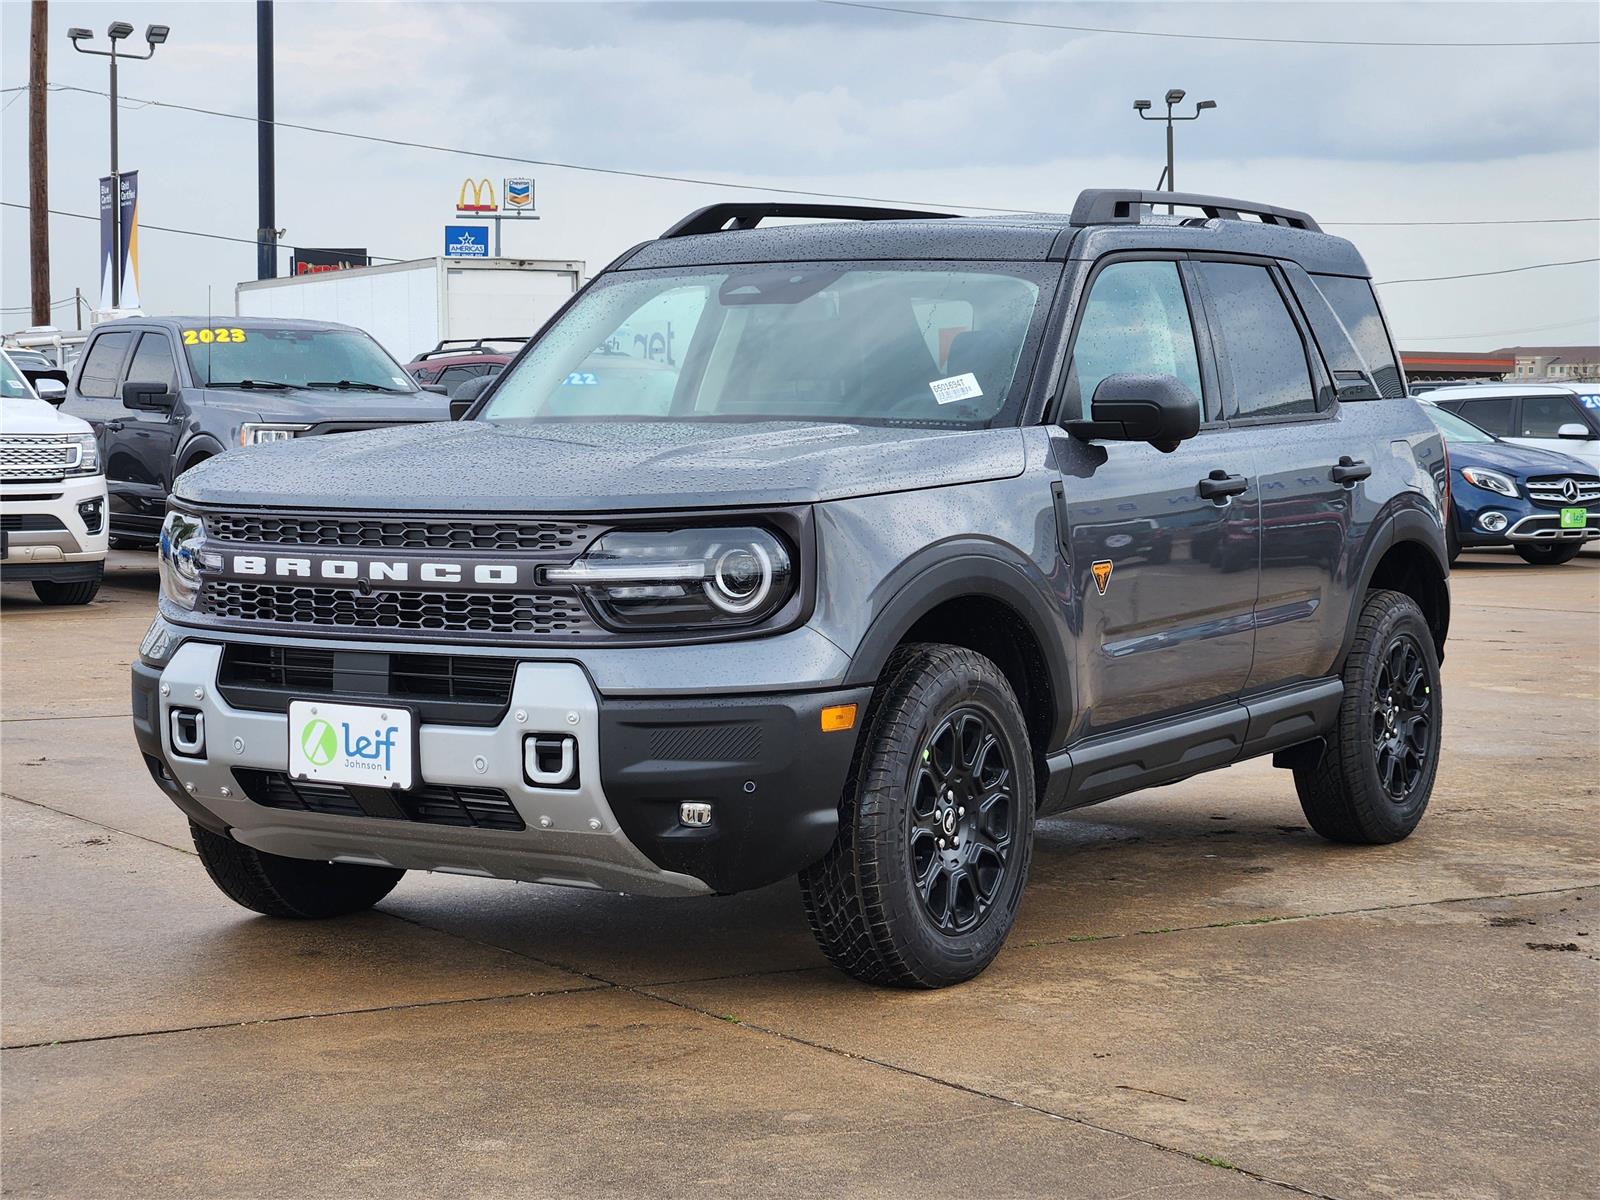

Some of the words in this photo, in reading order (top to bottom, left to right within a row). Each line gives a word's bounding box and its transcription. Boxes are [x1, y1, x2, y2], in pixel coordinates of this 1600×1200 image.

[183, 328, 246, 345] 2023
[233, 556, 517, 584] BRONCO
[344, 759, 382, 771] Johnson
